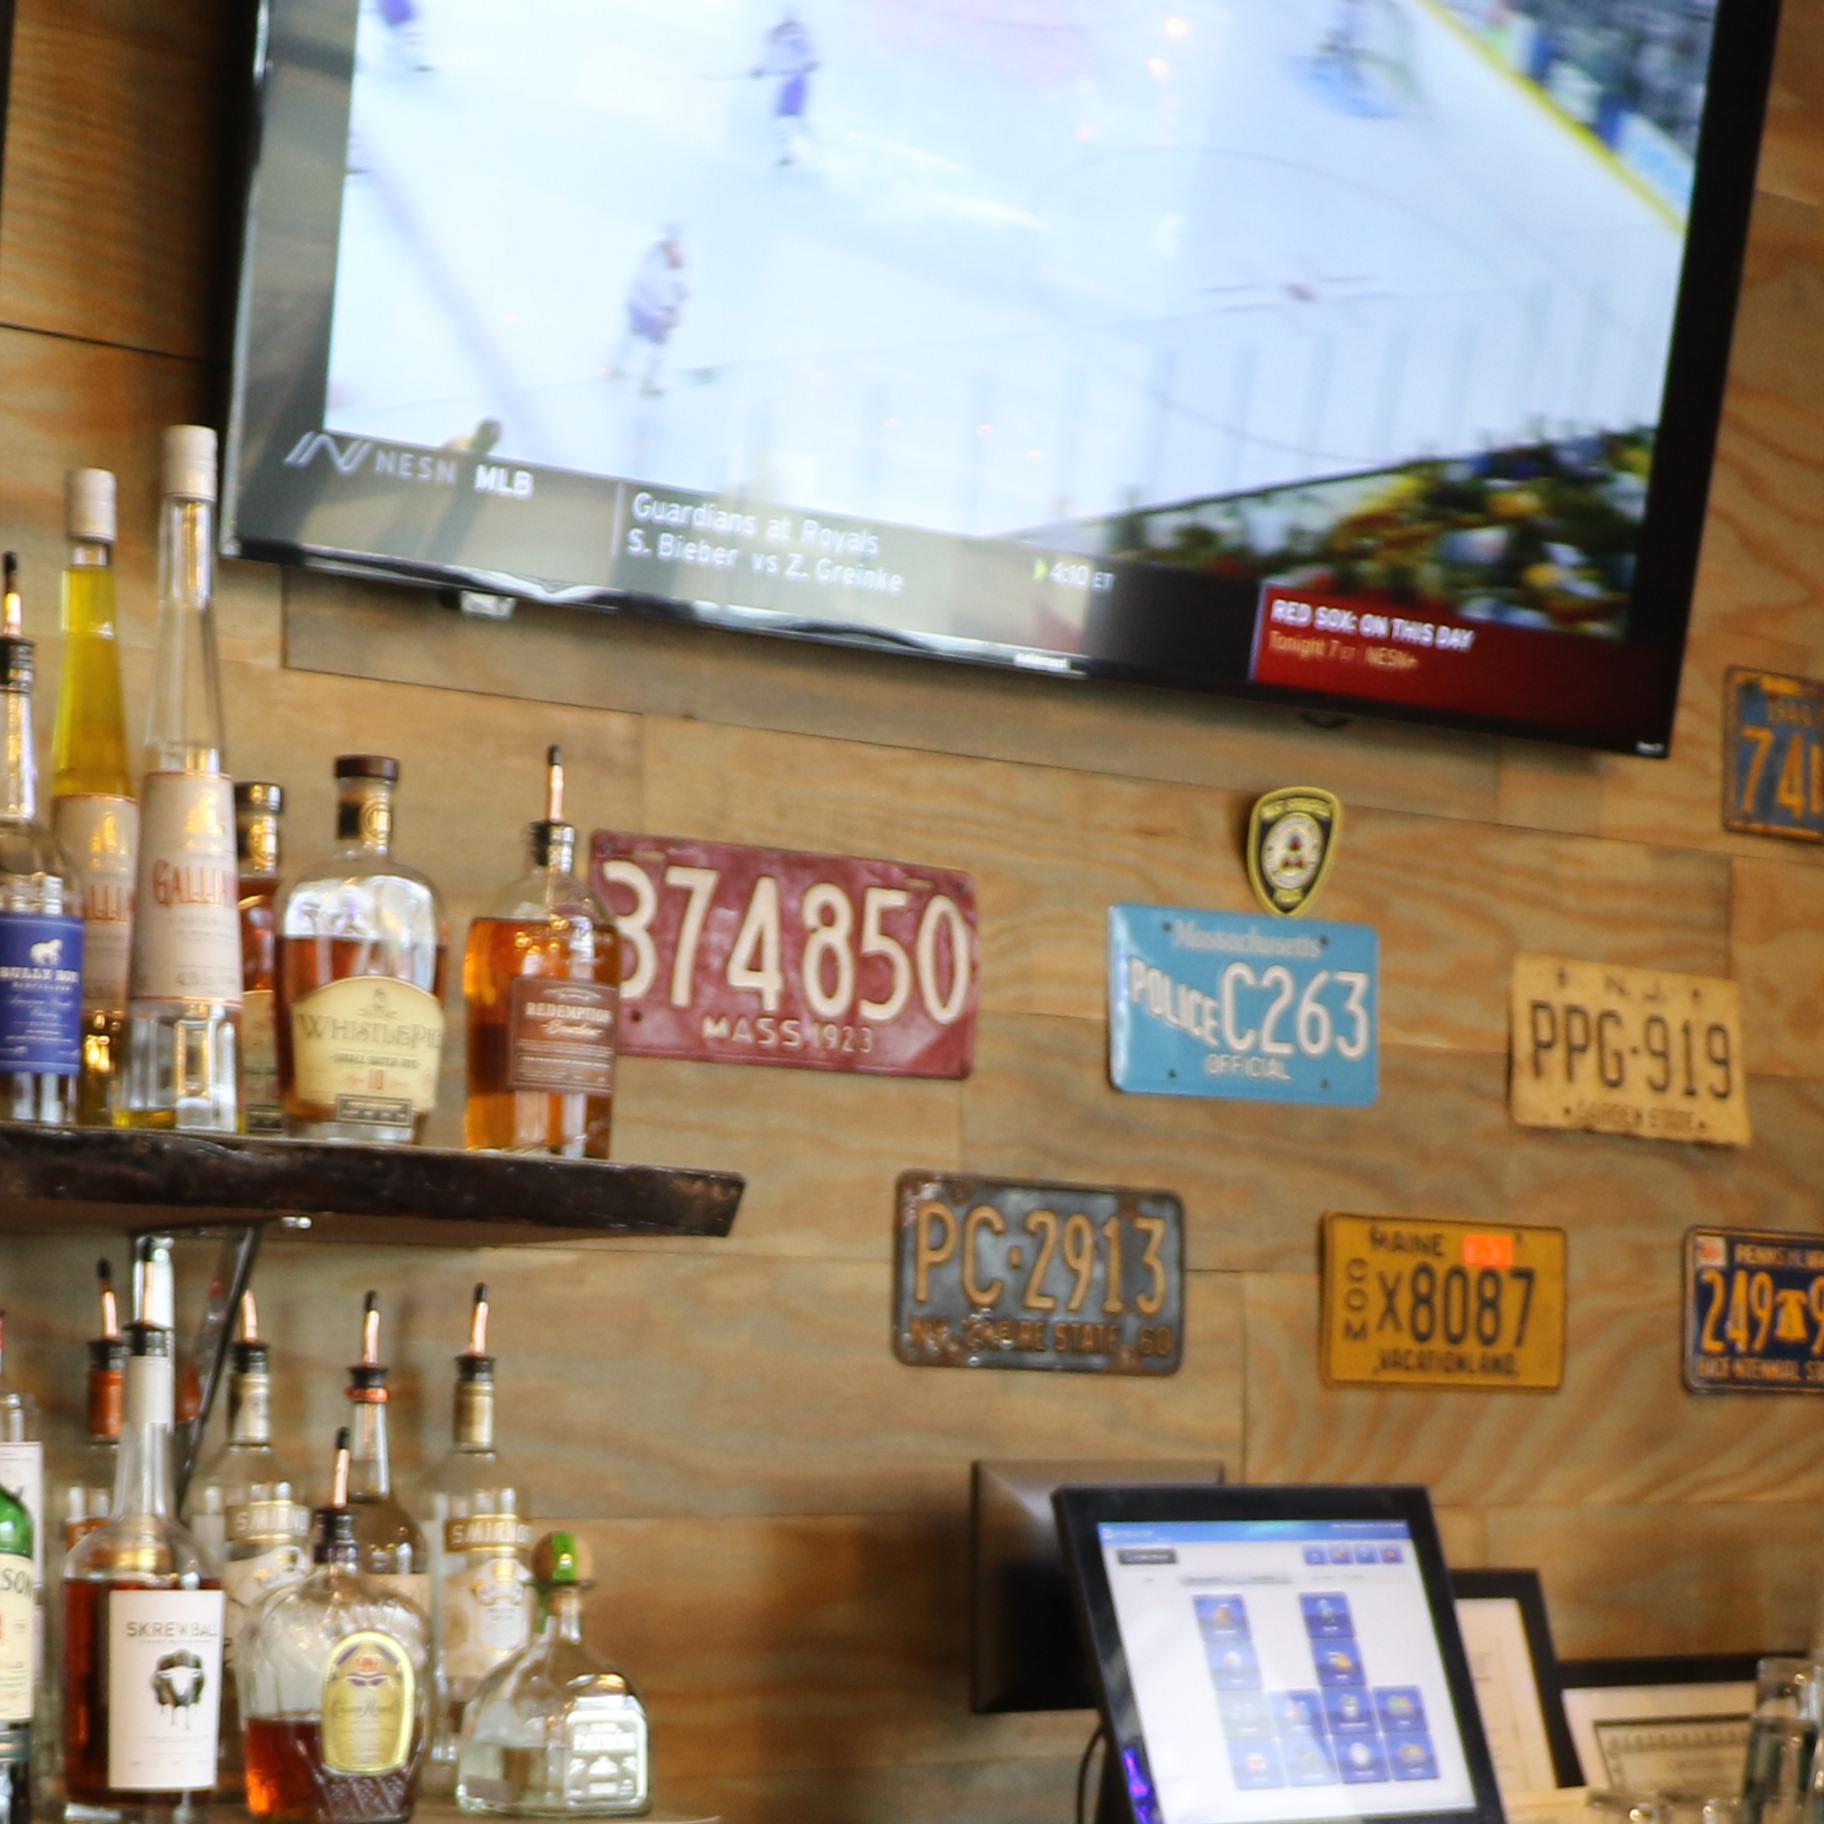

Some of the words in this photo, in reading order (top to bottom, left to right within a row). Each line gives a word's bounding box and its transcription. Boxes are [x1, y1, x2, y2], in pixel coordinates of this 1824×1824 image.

[376, 449, 457, 486] NESN
[476, 464, 533, 498] MLB
[632, 492, 756, 536] Guardians
[766, 512, 791, 536] at
[801, 518, 880, 556] Royals
[627, 530, 652, 557] S.
[658, 533, 737, 570] Bieber
[752, 552, 779, 574] vs
[785, 552, 810, 578] Z.
[815, 556, 903, 594] Greinke
[1049, 561, 1088, 590] 4:10
[1270, 631, 1325, 658] Tonight
[1271, 599, 1312, 627] RED
[1359, 613, 1389, 638] ON
[1391, 618, 1434, 647] THIS
[1436, 626, 1475, 651] DAY
[602, 859, 970, 1026] 374850
[1128, 956, 1220, 1048] POLICE
[1221, 961, 1369, 1059] C263
[1204, 1052, 1291, 1082] OFFICIAL
[1369, 1224, 1446, 1258] MAINE
[1343, 1255, 1370, 1341] COM
[1699, 1267, 1775, 1355] 249
